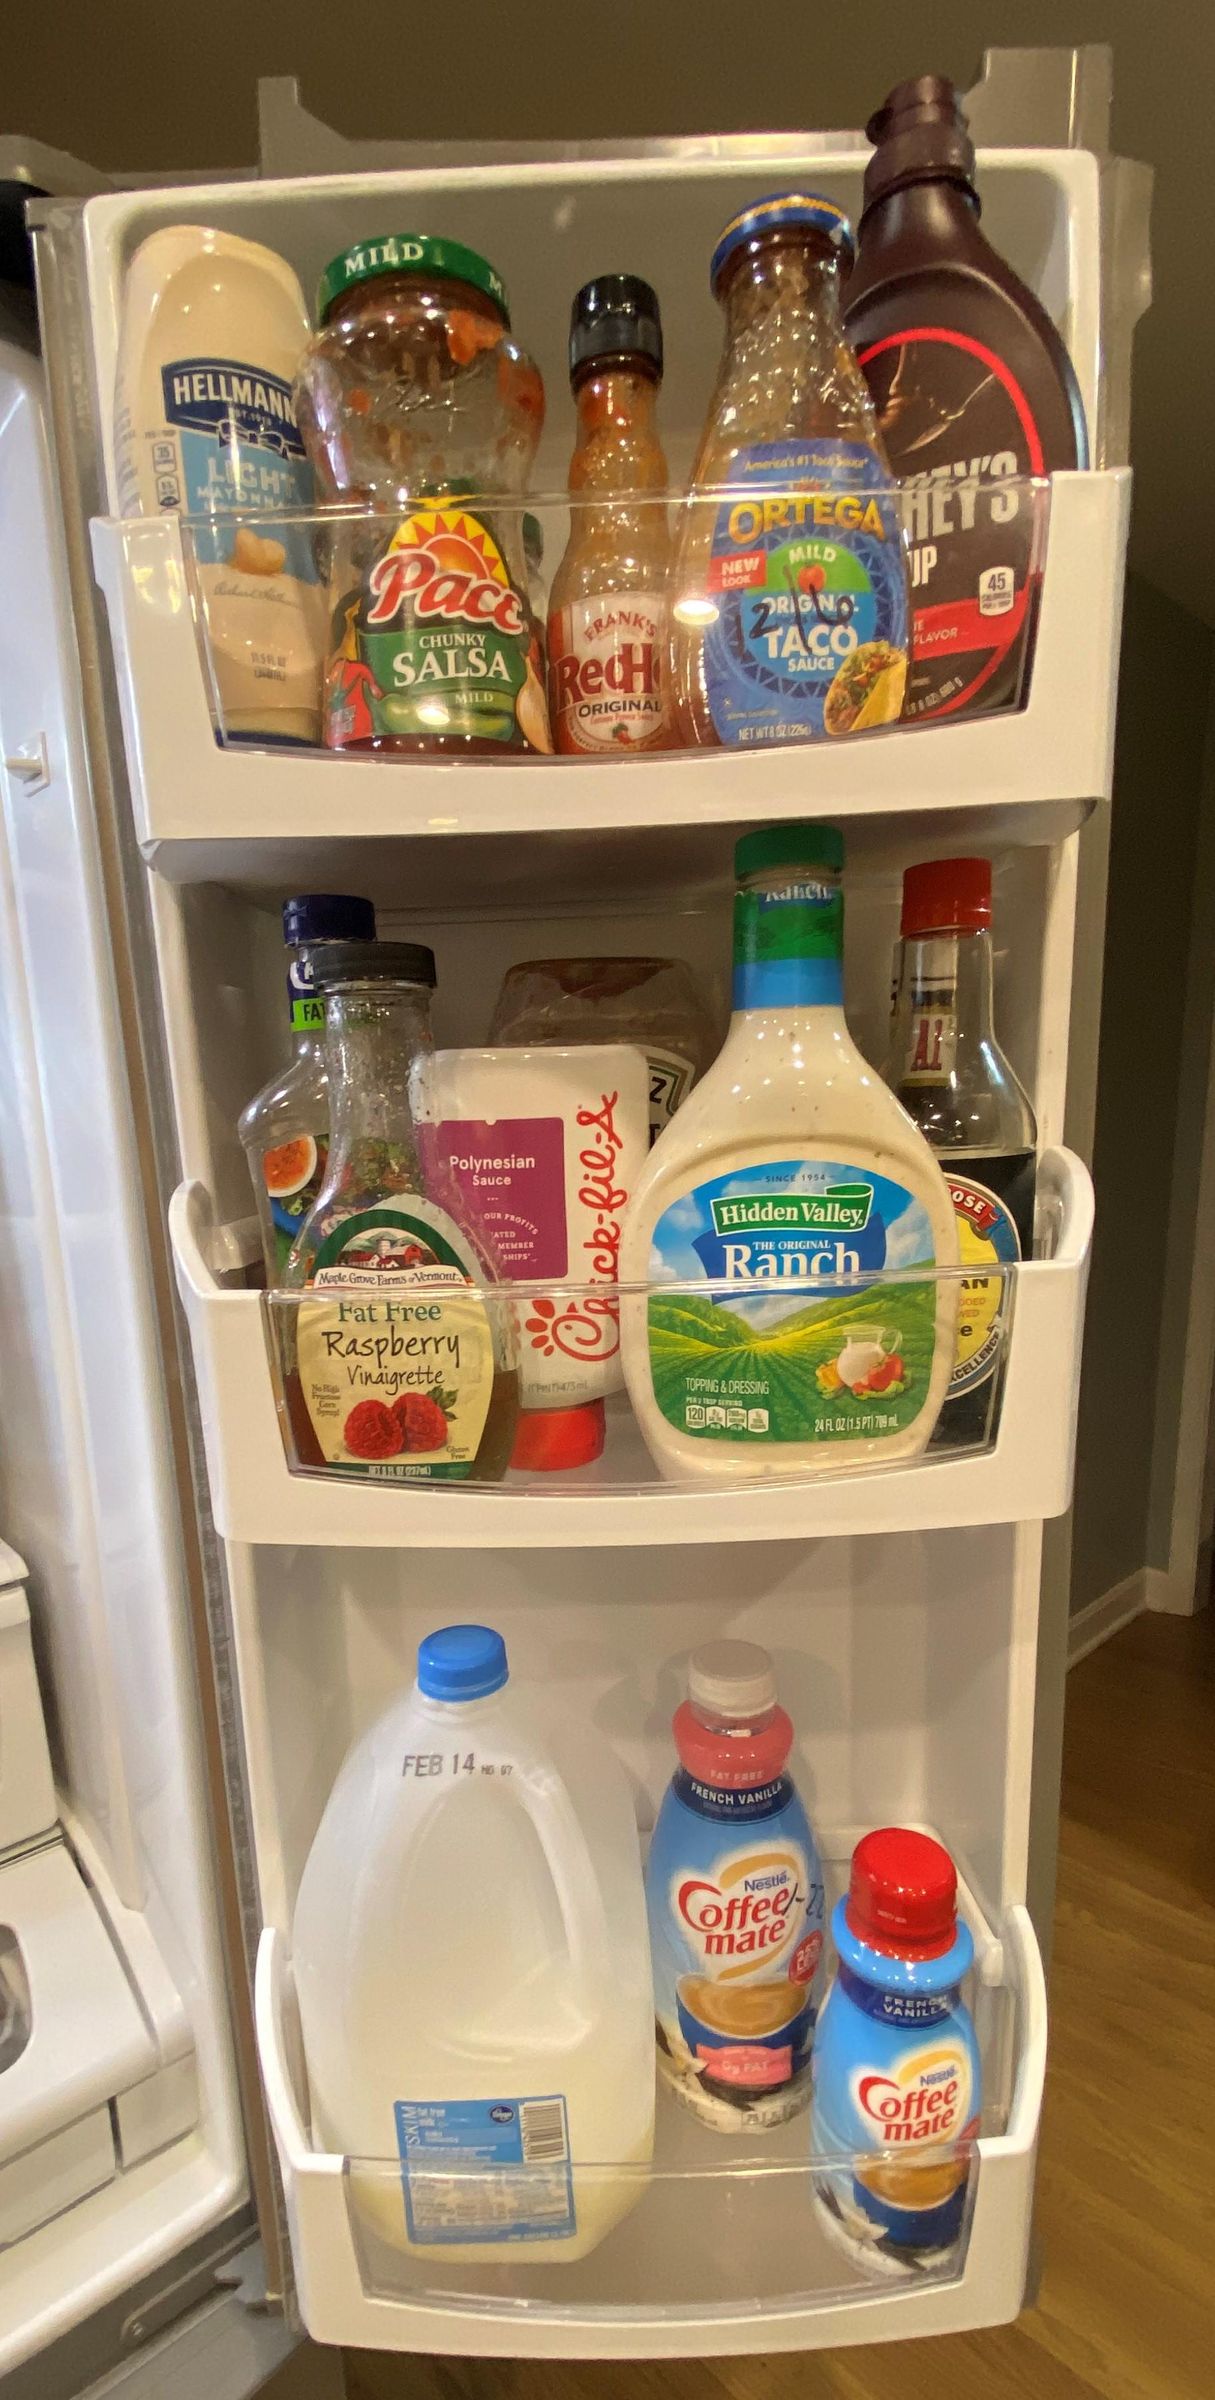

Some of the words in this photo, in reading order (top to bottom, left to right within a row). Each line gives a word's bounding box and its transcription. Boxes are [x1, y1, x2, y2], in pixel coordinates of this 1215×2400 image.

[345, 241, 425, 278] MILD
[207, 457, 296, 500] LIGHT
[728, 497, 886, 545] ORTEGA
[788, 544, 837, 564] MILD
[721, 556, 760, 576] NEW
[367, 549, 524, 635] Pace
[722, 574, 751, 588] LOOK
[987, 572, 1007, 592] 45
[584, 611, 657, 642] FRANK'S
[419, 633, 486, 649] CHUNKY
[763, 623, 858, 659] TACO
[393, 648, 512, 687] SALSA
[788, 656, 835, 672] SAUCE
[455, 693, 494, 705] MILD
[578, 700, 662, 718] ORIGINAL
[738, 727, 754, 741] NET
[755, 725, 769, 739] WT
[775, 724, 787, 738] OZ
[450, 1153, 536, 1174] Polynesian
[472, 1174, 512, 1186] Sauce
[766, 1174, 796, 1183] SINCE
[801, 1173, 826, 1182] 1954
[947, 1187, 986, 1214] OSE
[483, 1212, 502, 1220] OUR
[504, 1213, 539, 1235] PROFITS
[720, 1203, 798, 1226] Hidden
[800, 1202, 863, 1227] Valley
[498, 1242, 535, 1250] MEMBER
[752, 1241, 776, 1251] THE
[778, 1239, 831, 1251] ORIGINAL
[722, 1242, 860, 1279] Ranch
[319, 1272, 349, 1285] Maple
[349, 1273, 376, 1285] Grove
[377, 1274, 407, 1286] Farms
[415, 1271, 458, 1283] Vermont
[338, 1301, 378, 1322] Fat
[385, 1301, 441, 1322] Free
[321, 1325, 460, 1369] Raspberry
[347, 1364, 445, 1396] Vinaigrette
[685, 1377, 719, 1393] TOPPING
[720, 1380, 727, 1394] &
[728, 1380, 769, 1395] DRESSING
[688, 1407, 704, 1420] 120
[815, 1418, 824, 1432] 24
[825, 1418, 834, 1431] FL
[835, 1417, 846, 1431] OZ
[402, 1754, 444, 1777] FEB
[452, 1753, 475, 1775] 14
[710, 1769, 730, 1780] FAT
[733, 1770, 764, 1782] FREE
[691, 1782, 735, 1805] FRENCH
[738, 1782, 783, 1805] VANILLA
[744, 1870, 788, 1892] Nestlé
[678, 1880, 789, 1933] Coffee
[705, 1919, 785, 1955] mate
[859, 2076, 958, 2122] Coffee
[401, 2105, 420, 2146] SKIM
[883, 2109, 954, 2142] mate
